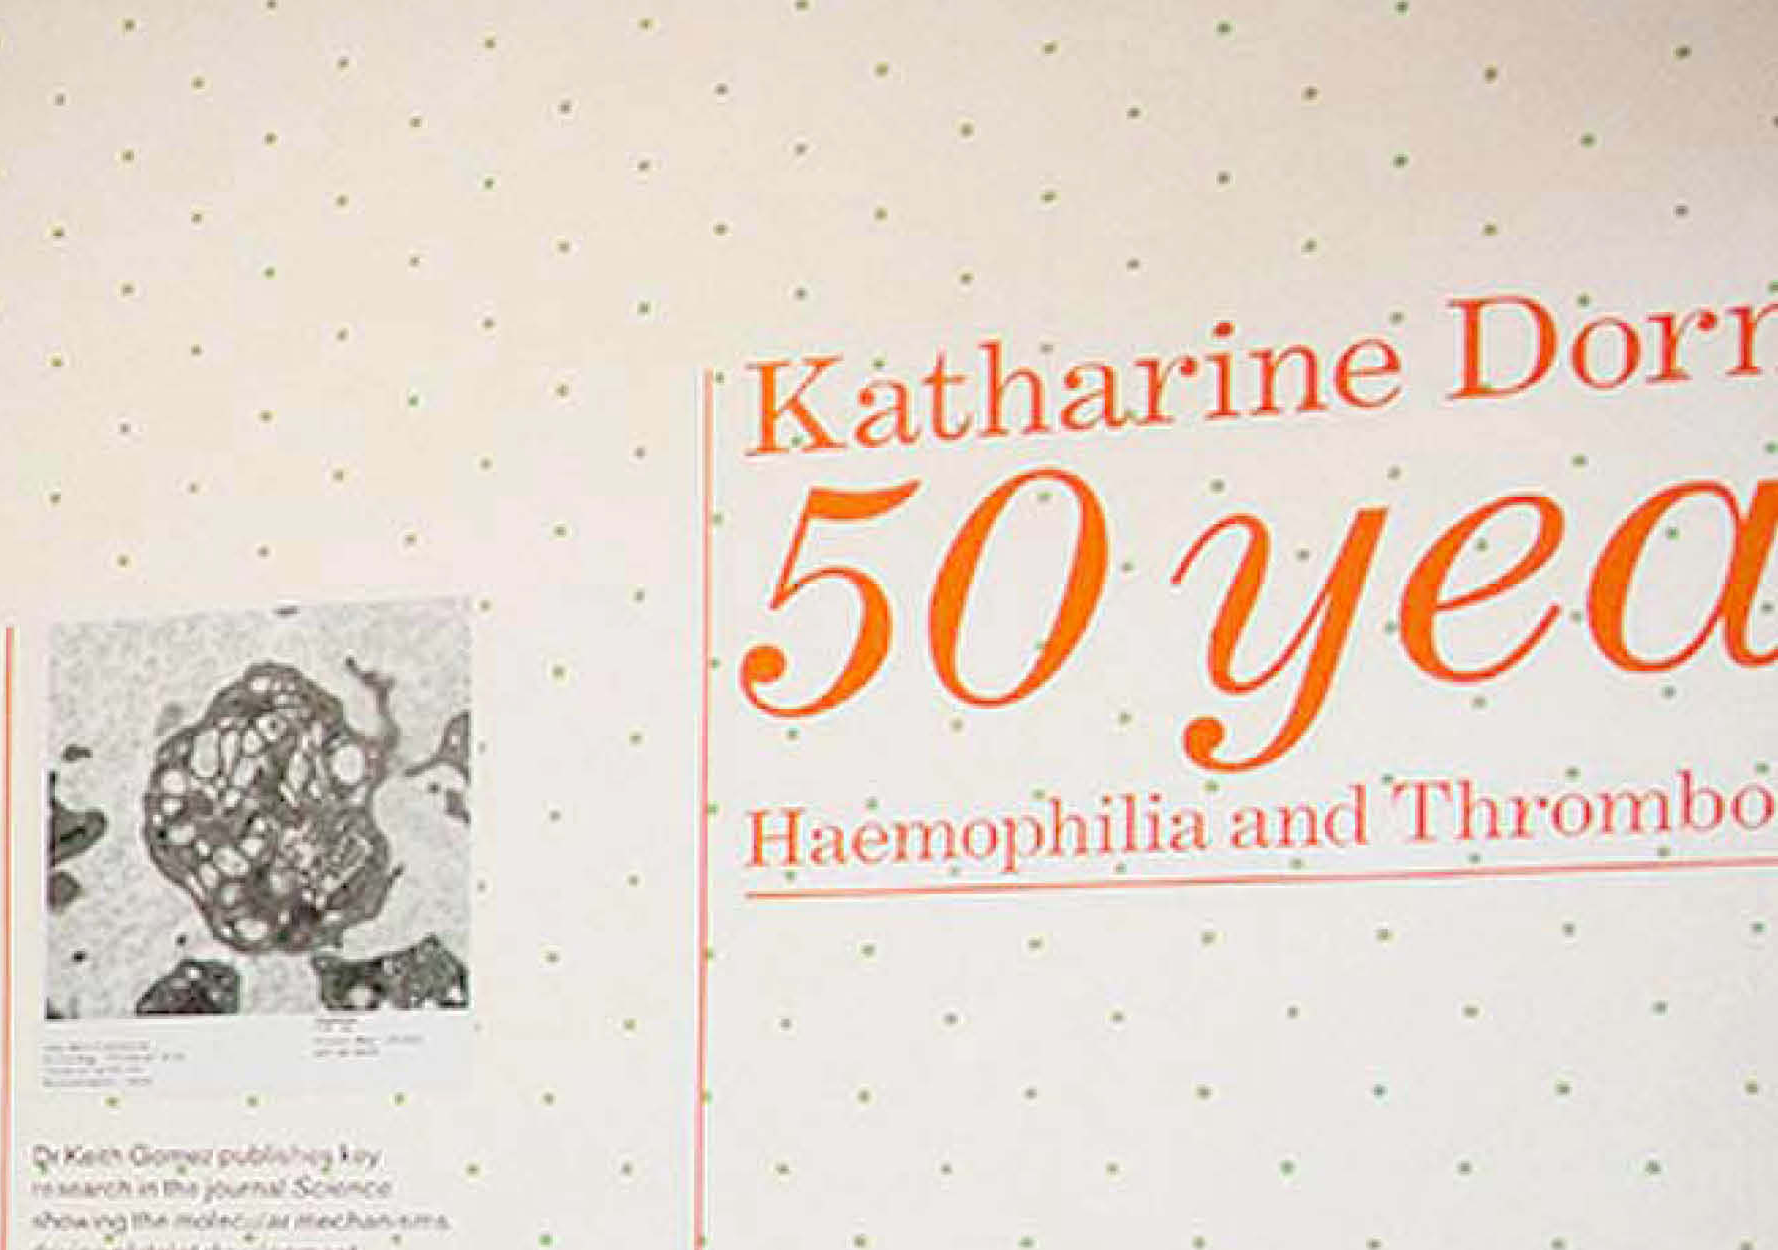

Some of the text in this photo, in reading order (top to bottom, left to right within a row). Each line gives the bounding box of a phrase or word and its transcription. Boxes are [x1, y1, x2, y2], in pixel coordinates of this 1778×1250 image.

[745, 323, 1402, 456] Katharine
[739, 466, 1778, 775] 50 yea
[745, 768, 1776, 874] Haemophilia and Thrombo
